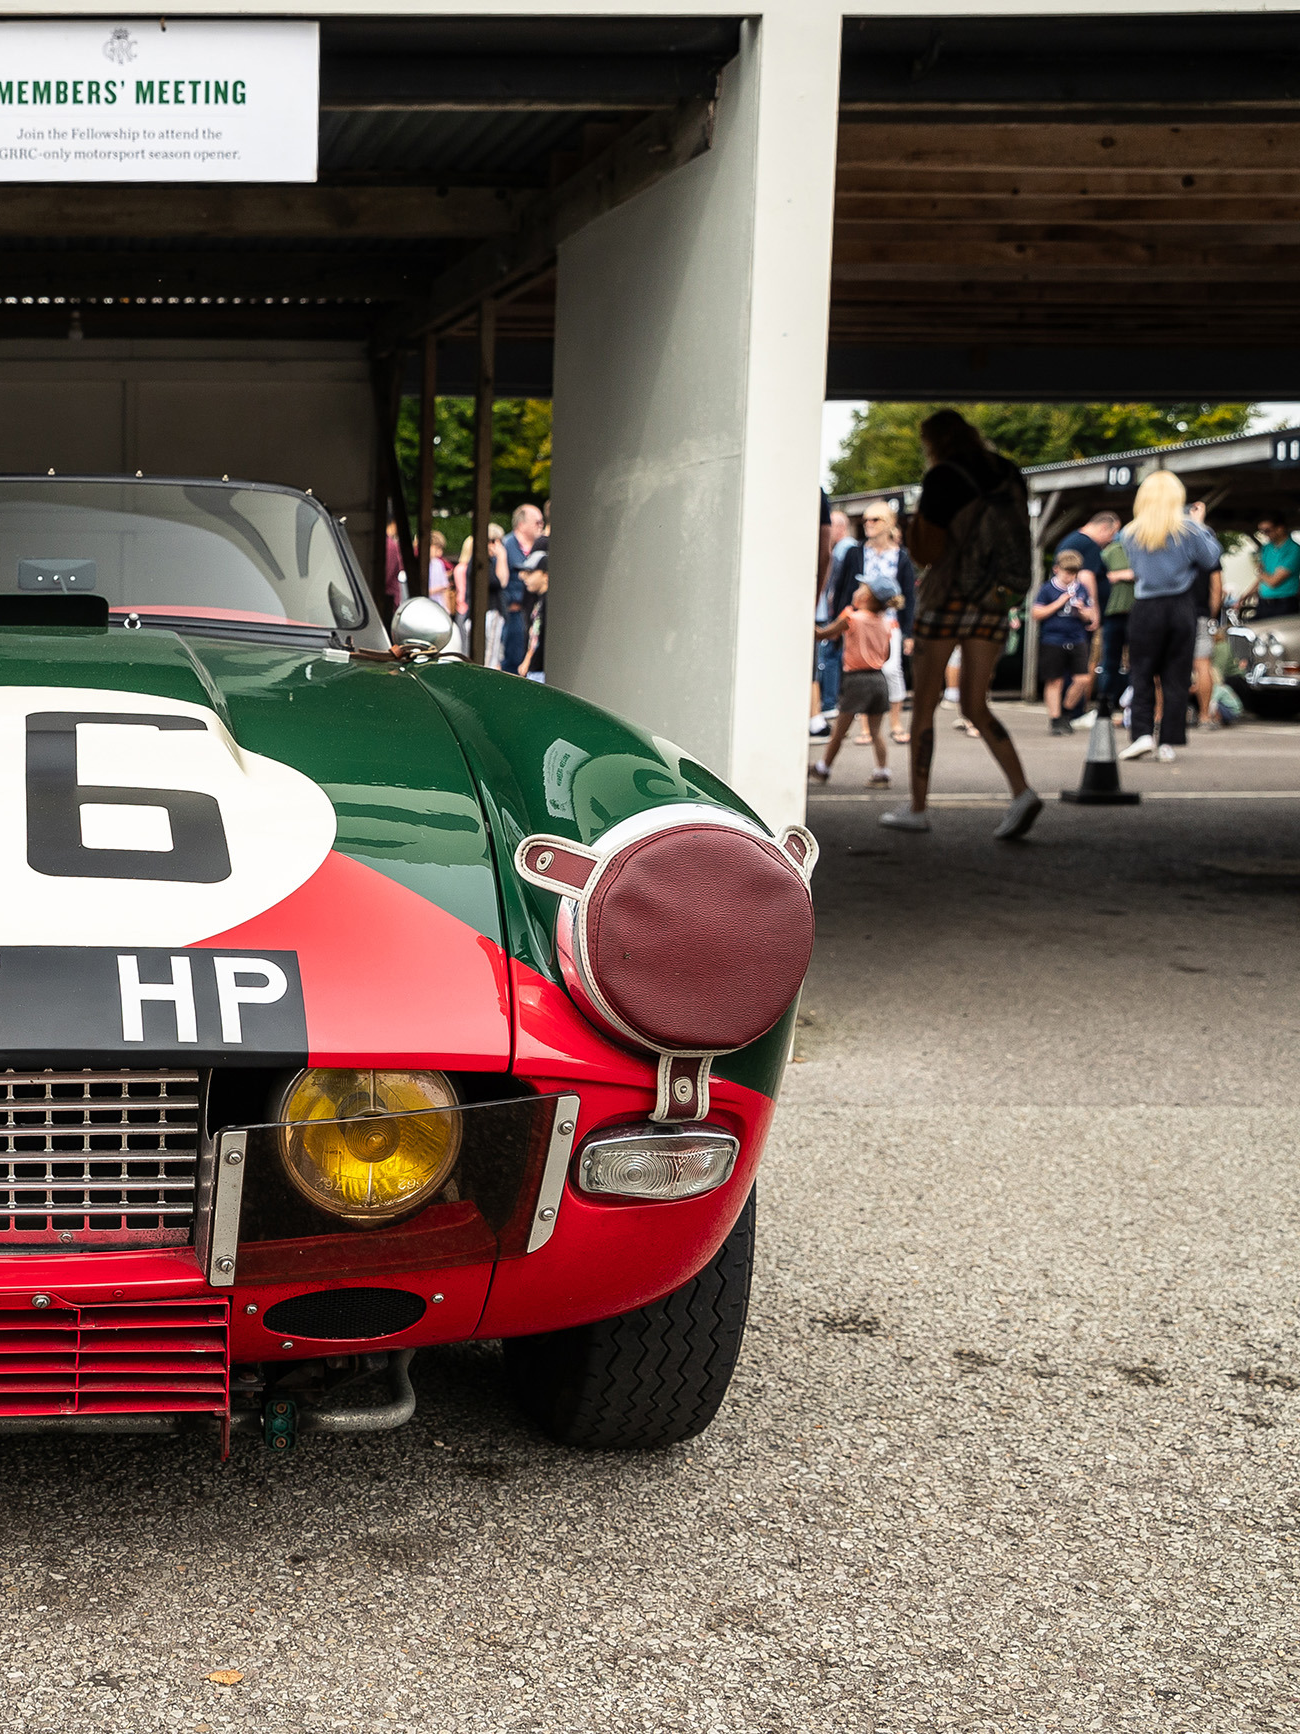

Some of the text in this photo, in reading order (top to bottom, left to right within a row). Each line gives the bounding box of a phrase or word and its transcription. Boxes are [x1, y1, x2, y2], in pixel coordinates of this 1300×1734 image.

[135, 80, 247, 105] MEETING
[16, 128, 223, 144] Join the Fellowship to attend the
[74, 149, 146, 163] motorsport
[148, 152, 191, 161] season
[194, 151, 241, 163] opener.
[1109, 466, 1131, 485] 10
[117, 954, 290, 1044] HP
